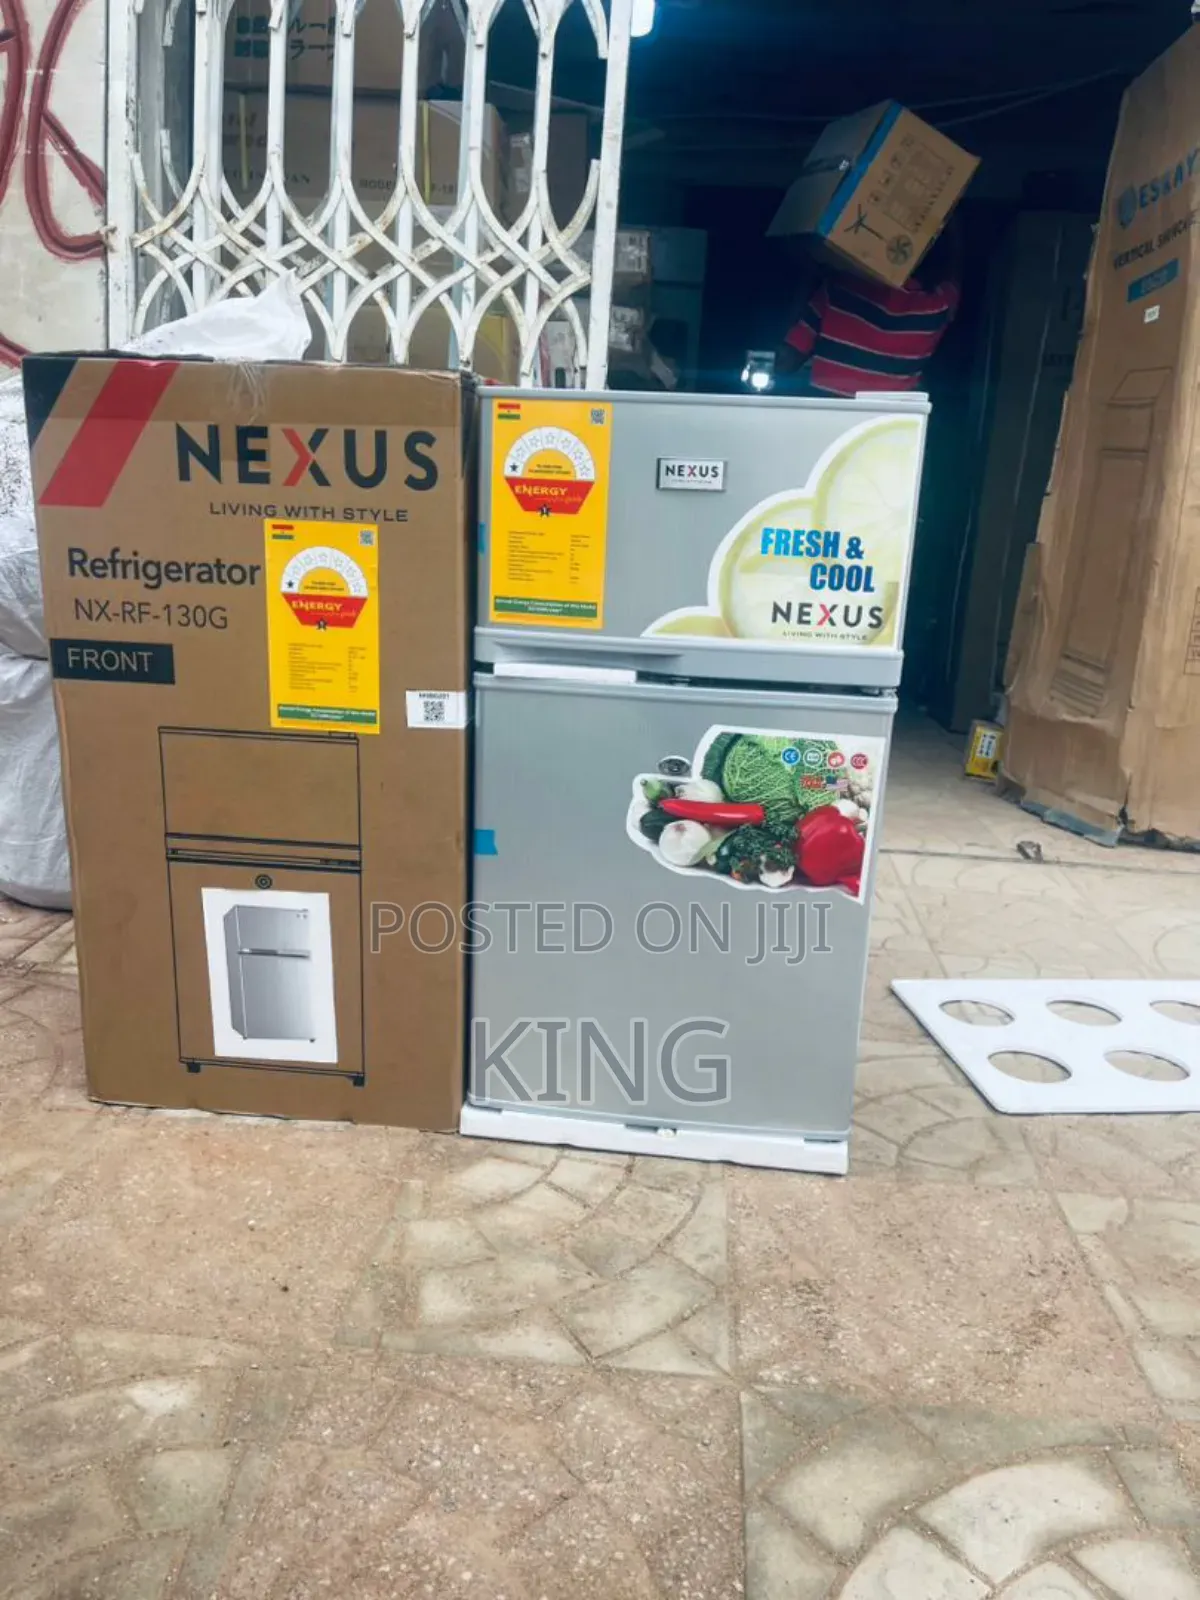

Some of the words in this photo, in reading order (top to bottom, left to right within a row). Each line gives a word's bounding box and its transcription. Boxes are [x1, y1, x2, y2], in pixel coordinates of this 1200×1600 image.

[175, 422, 439, 491] NEXUS
[665, 464, 719, 478] NEXUS
[514, 484, 569, 497] ENERGY
[209, 502, 277, 518] LIVING
[284, 505, 336, 520] WITH
[343, 507, 409, 523] STYLE
[760, 527, 841, 558] FRESH
[845, 536, 865, 560] &
[67, 547, 261, 590] Refrigerator
[809, 562, 876, 593] COOL
[74, 598, 228, 630] NX-RF-130G
[291, 599, 344, 611] ENERGY
[770, 601, 884, 629] NEXUS
[67, 647, 154, 672] FRONT
